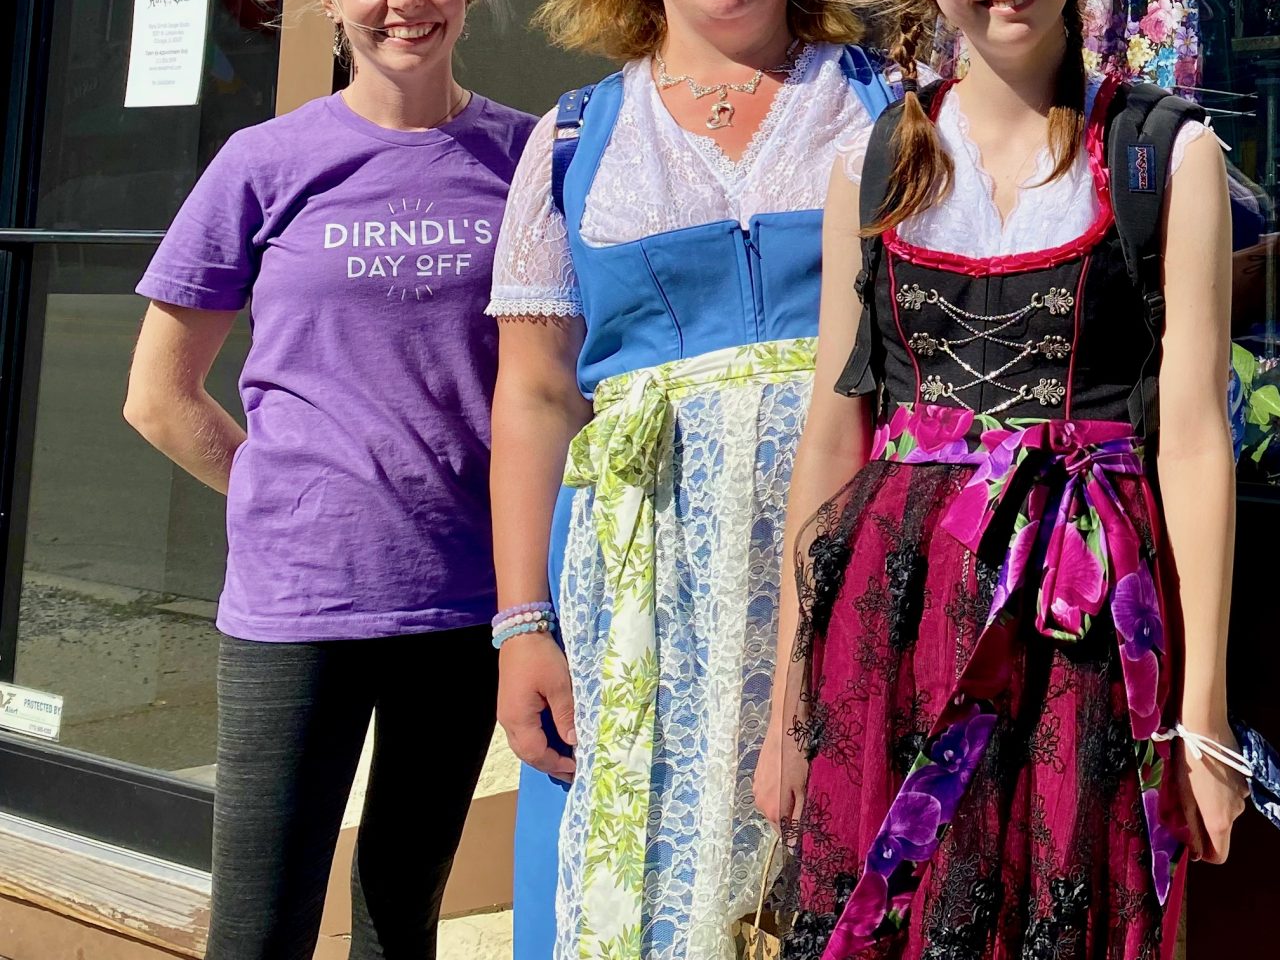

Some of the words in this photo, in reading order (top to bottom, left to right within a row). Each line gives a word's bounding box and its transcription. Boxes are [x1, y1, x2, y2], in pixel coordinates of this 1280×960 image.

[324, 219, 493, 248] DIRNDL'S
[347, 255, 405, 278] DAY
[416, 254, 472, 277] OFF
[24, 698, 52, 714] PROTECTED
[54, 705, 61, 716] BY
